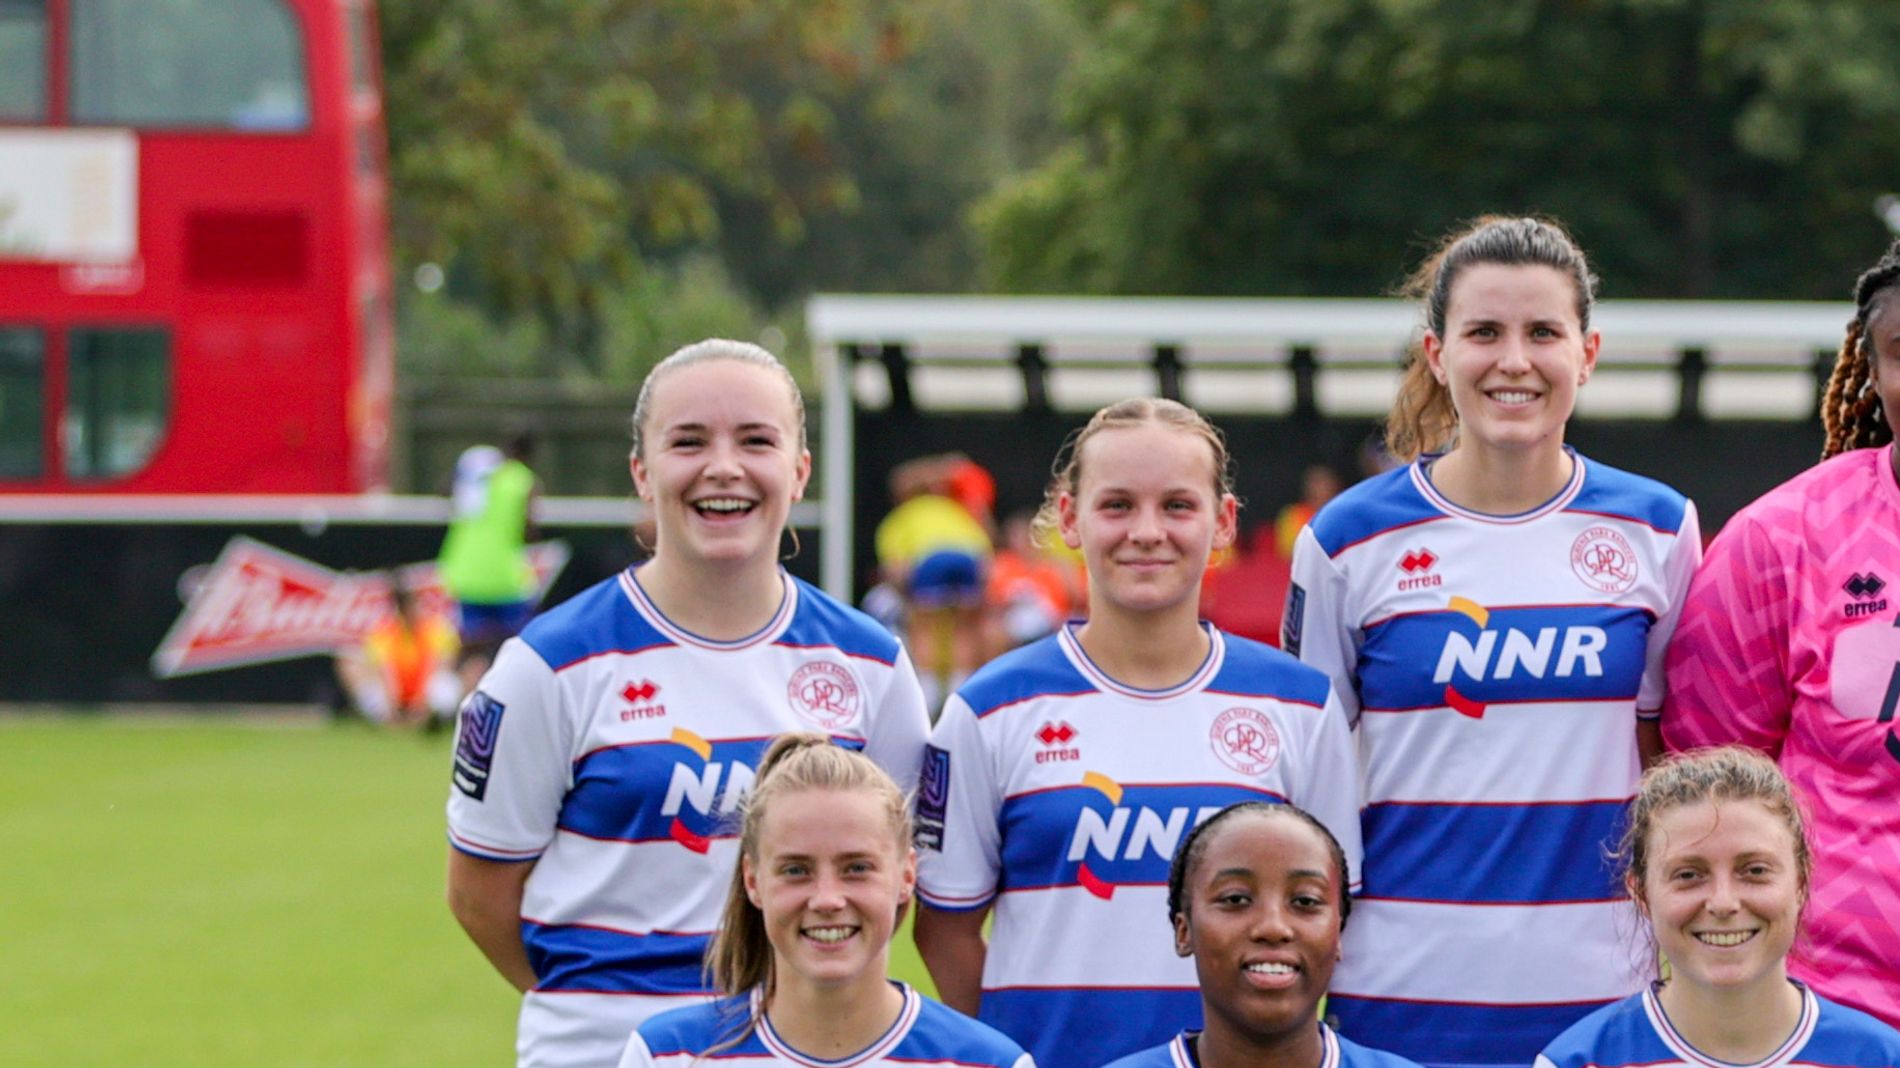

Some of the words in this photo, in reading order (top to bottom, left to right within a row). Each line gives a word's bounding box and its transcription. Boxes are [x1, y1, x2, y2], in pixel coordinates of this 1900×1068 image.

[1398, 573, 1442, 591] errea
[1844, 599, 1887, 618] errea
[1433, 626, 1607, 684] NNR
[620, 704, 666, 722] errea
[1035, 746, 1080, 764] errea
[661, 760, 755, 816] NN
[1067, 806, 1225, 862] NN
